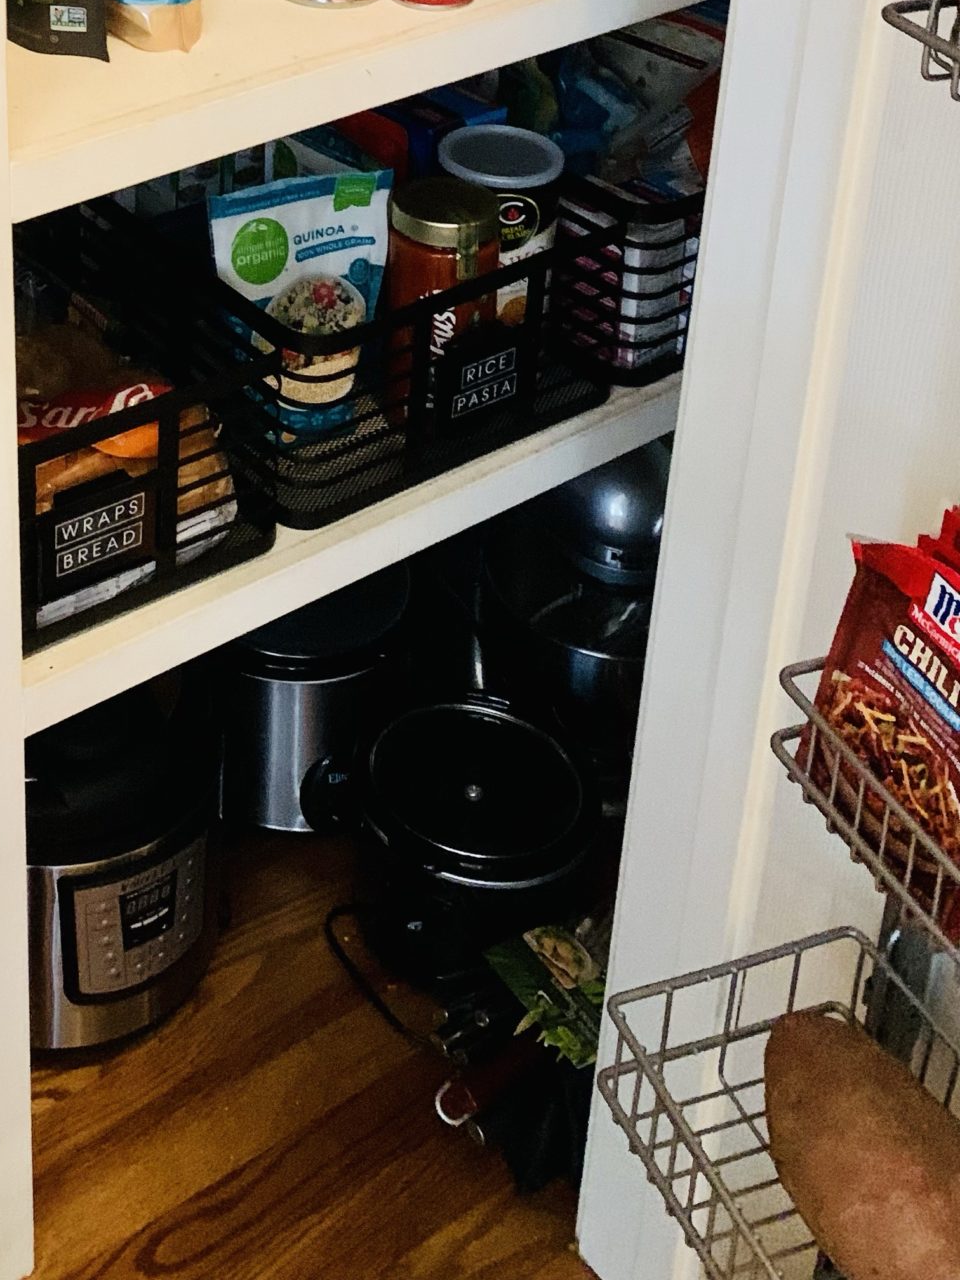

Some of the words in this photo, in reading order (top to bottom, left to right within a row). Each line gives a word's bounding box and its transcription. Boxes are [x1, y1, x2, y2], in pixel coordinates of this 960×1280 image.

[292, 224, 345, 246] QUINOA
[315, 242, 343, 255] WHOLE
[236, 245, 286, 268] organic
[466, 354, 508, 383] RICE
[456, 379, 510, 412] PASTA
[61, 499, 139, 541] WRAPS
[63, 529, 136, 570] BREAD
[893, 624, 960, 708] CHILI
